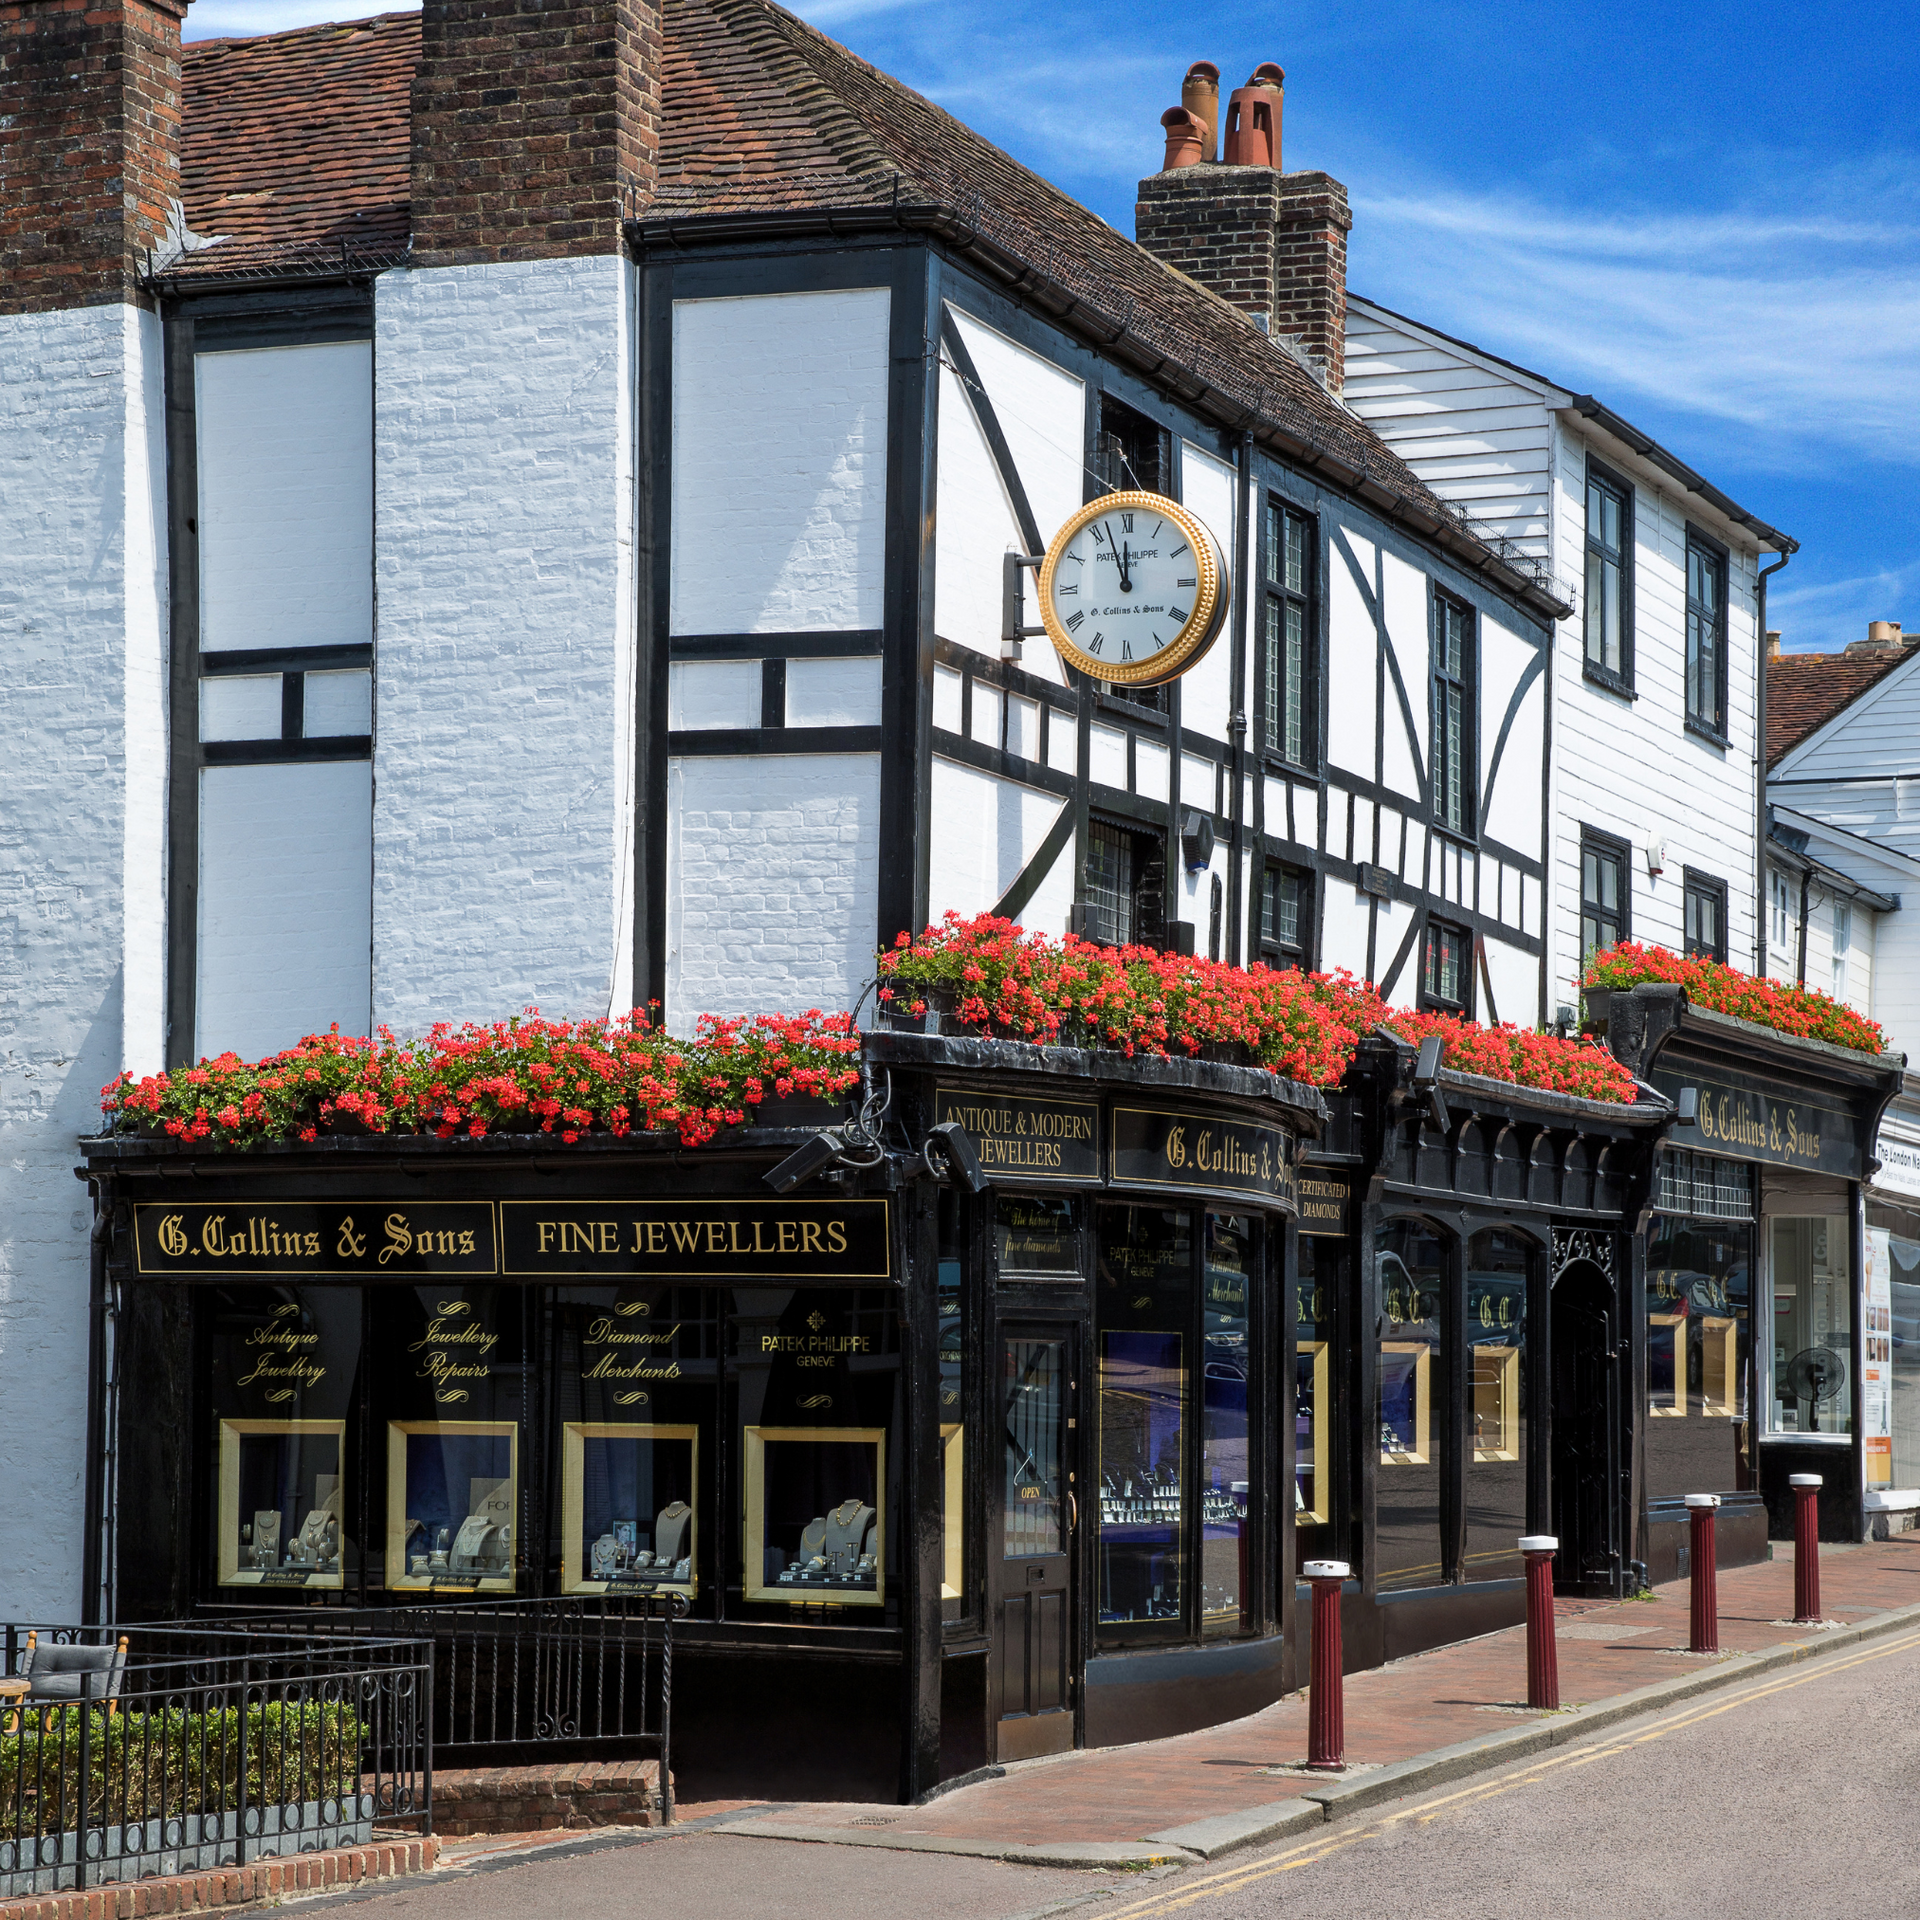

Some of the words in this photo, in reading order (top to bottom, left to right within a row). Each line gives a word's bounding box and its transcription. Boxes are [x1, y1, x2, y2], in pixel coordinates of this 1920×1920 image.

[1096, 552, 1121, 562] PATEK
[1103, 606, 1131, 616] Collins
[1133, 605, 1141, 614] &
[1142, 604, 1164, 614] Sons
[946, 1106, 1012, 1138] ANTIQUE
[1015, 1111, 1028, 1137] &
[1030, 1113, 1092, 1140] MODERN
[1700, 1090, 1767, 1148] G.Collins
[1770, 1107, 1783, 1152] &
[1784, 1108, 1820, 1161] Sons
[978, 1139, 1060, 1167] JEWELLERS
[1166, 1125, 1257, 1176] G.Collins
[1261, 1141, 1272, 1181] &
[1274, 1144, 1293, 1190] So
[1877, 1142, 1888, 1162] The
[1889, 1147, 1911, 1168] London
[1298, 1179, 1346, 1198] CERTIFICATED
[1028, 1208, 1051, 1228] home
[1051, 1209, 1061, 1235] of
[1303, 1201, 1341, 1219] DIAMONDS
[158, 1214, 322, 1257] G.Collins
[336, 1215, 366, 1257] &
[378, 1213, 476, 1265] Sons
[536, 1221, 620, 1253] FINE
[630, 1220, 847, 1254] JEWELLERS
[1004, 1233, 1022, 1260] fine
[1109, 1246, 1137, 1263] PATEK
[1138, 1248, 1174, 1265] PHILIPPE
[1130, 1266, 1155, 1278] GENEVE
[246, 1321, 319, 1352] Antique
[407, 1318, 499, 1354] Jewellery
[583, 1318, 680, 1345] Diamond
[762, 1336, 805, 1352] PATEK
[809, 1336, 870, 1352] PHILIPPE
[237, 1352, 326, 1388] Jewellery
[416, 1351, 490, 1385] Repairs
[581, 1353, 681, 1379] Merchants
[796, 1355, 835, 1367] GENEVE
[1021, 1486, 1041, 1499] OPEN
